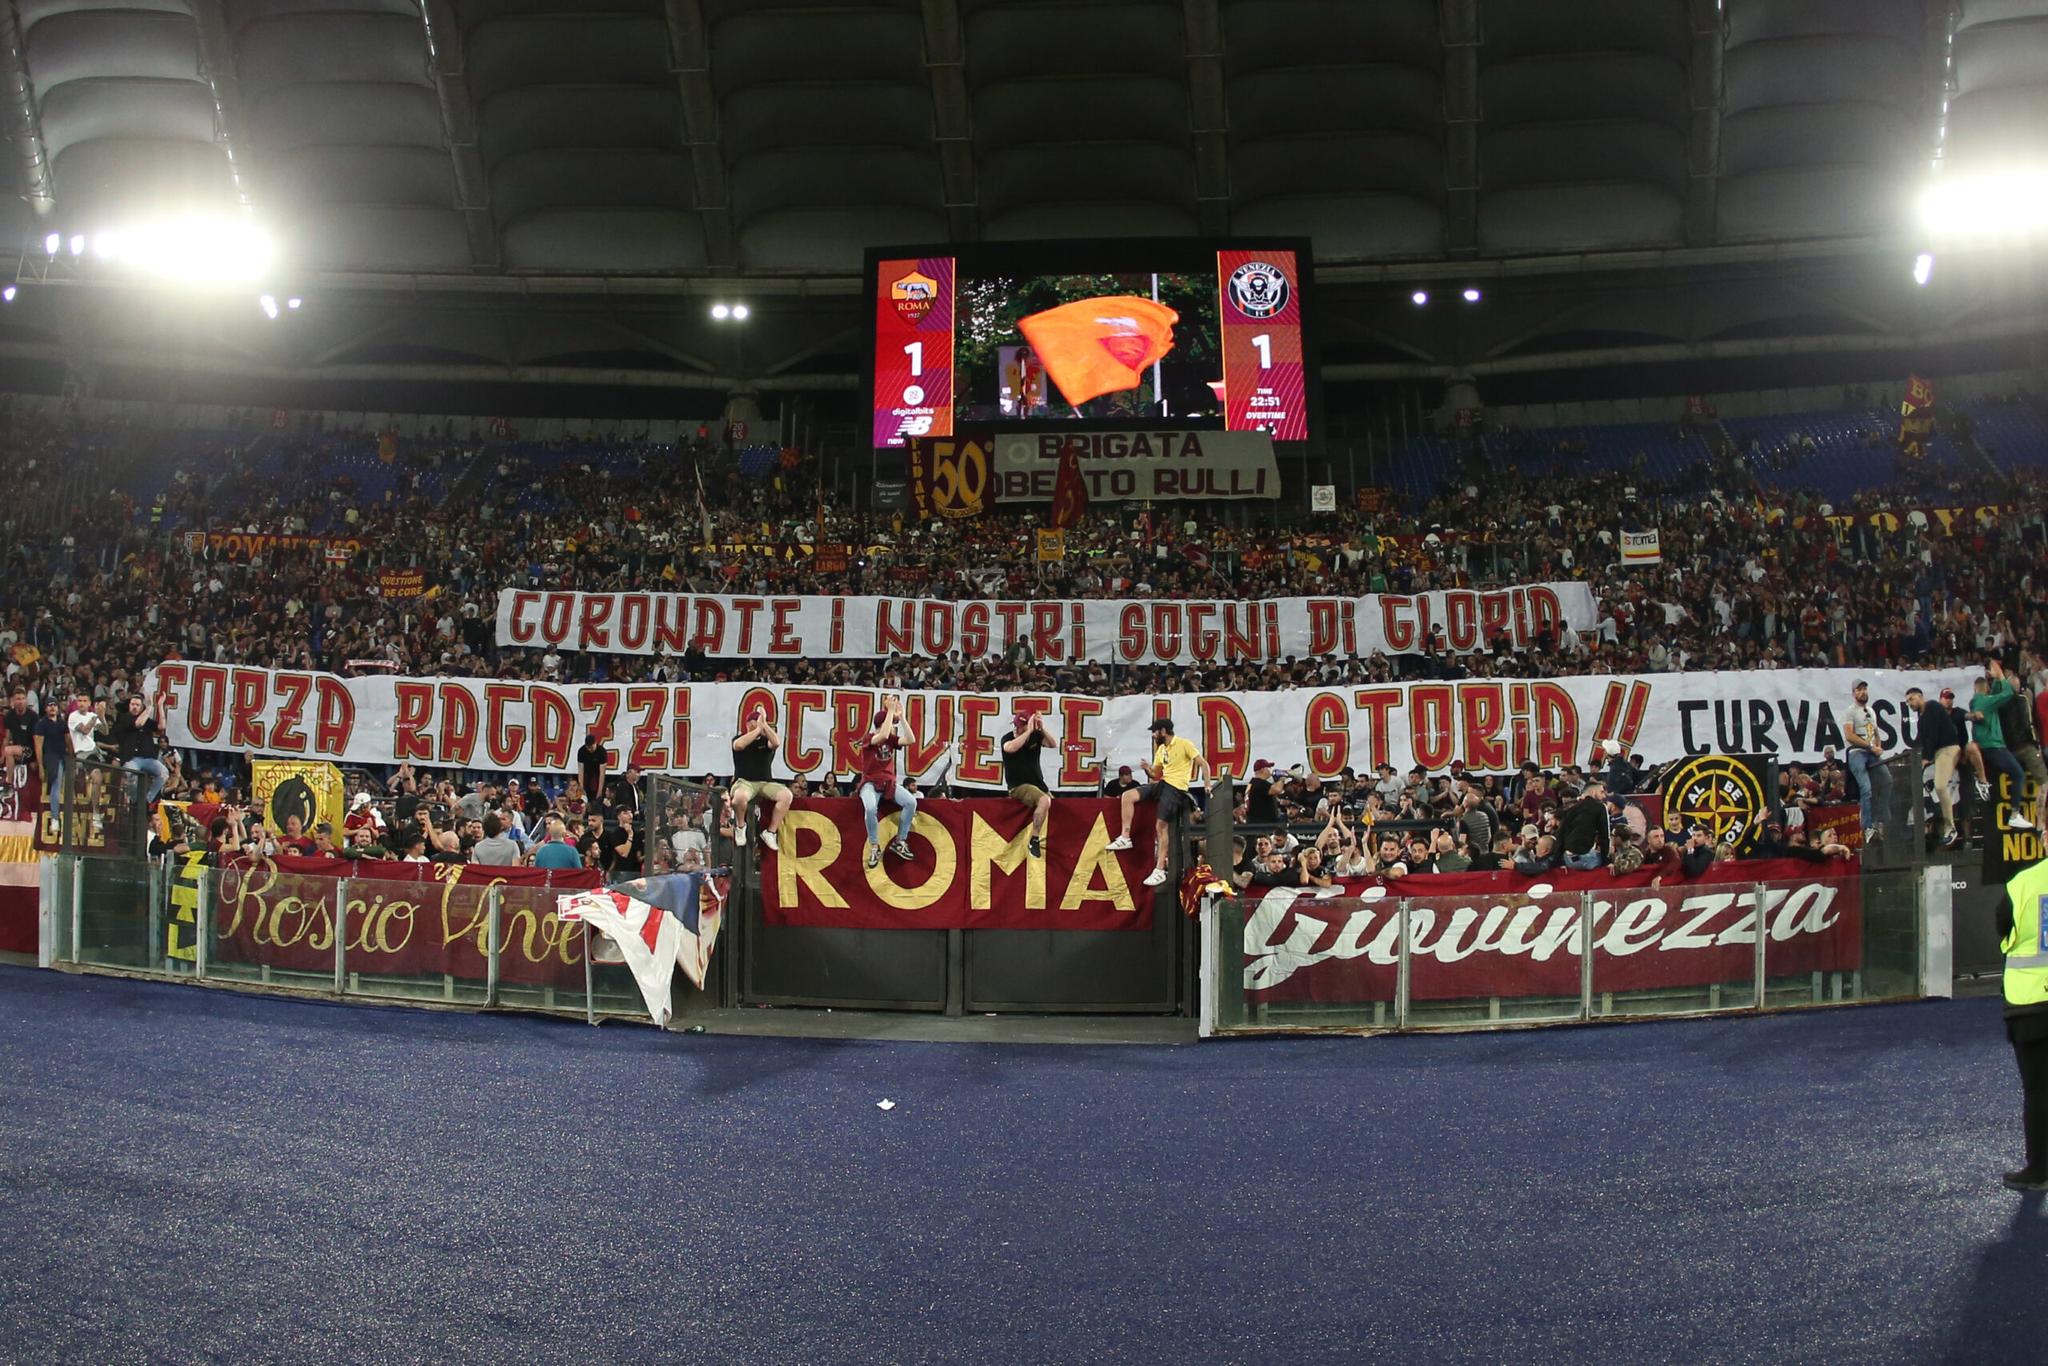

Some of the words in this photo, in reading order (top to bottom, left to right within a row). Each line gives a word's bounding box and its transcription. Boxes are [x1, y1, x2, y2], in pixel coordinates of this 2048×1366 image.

[1237, 263, 1277, 275] VENEZIA
[898, 302, 930, 311] ROMA
[903, 341, 922, 376] 1
[1251, 334, 1271, 369] 1
[892, 407, 935, 417] digitalbits
[1246, 411, 1287, 420] OVERTIME
[1250, 396, 1280, 407] 22:51
[1038, 432, 1204, 460] BRIGATA
[1154, 467, 1267, 496] RULLI
[379, 575, 424, 586] QUESTIONE
[397, 586, 424, 597] CORE
[510, 590, 802, 655] CORONATE
[829, 598, 844, 654] I
[875, 599, 1086, 662] NOSTRI
[1119, 599, 1281, 662] SOGNI
[1307, 598, 1357, 657] DI
[156, 663, 356, 757] FORZA
[393, 681, 692, 770] RAGAZZI
[1677, 698, 1846, 755] CURVA
[777, 808, 1137, 911] ROMA
[219, 855, 420, 954] Roscio
[1242, 883, 1841, 991] Giovinezza
